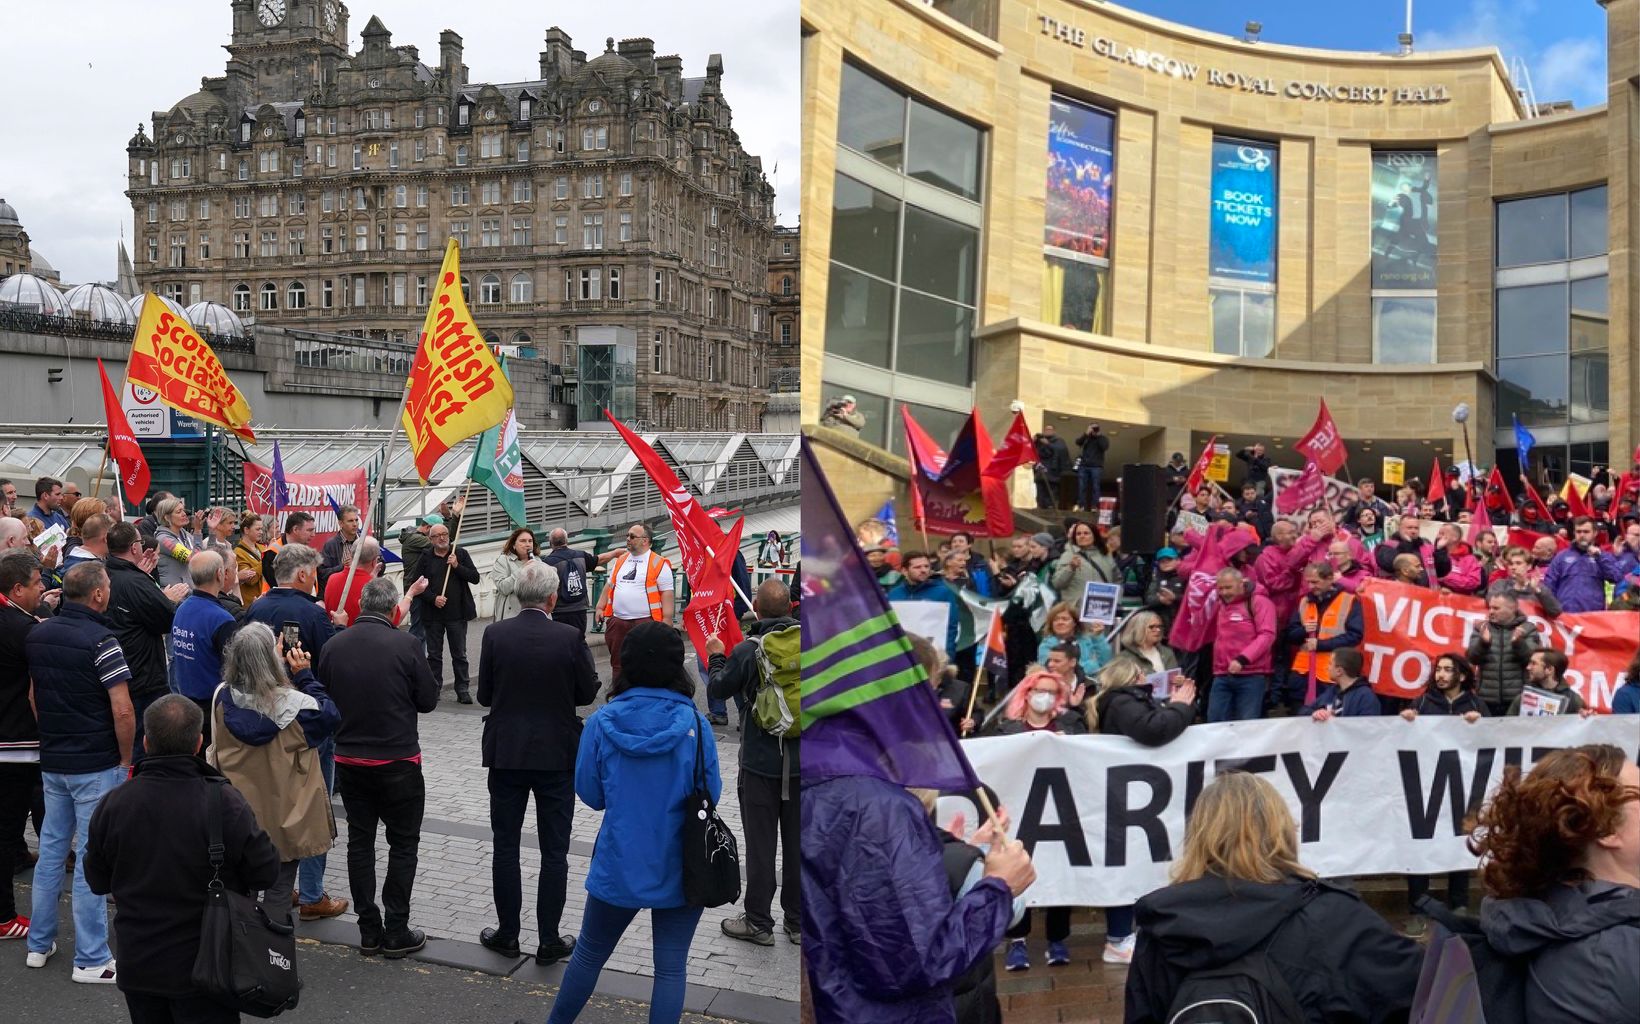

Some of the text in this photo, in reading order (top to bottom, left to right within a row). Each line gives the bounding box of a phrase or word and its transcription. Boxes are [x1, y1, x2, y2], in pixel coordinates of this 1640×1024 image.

[1038, 15, 1451, 104] THE GLASGOW ROYAL CONCERT HALL
[1224, 189, 1264, 204] BOOK
[1214, 199, 1272, 217] TICKETS
[1225, 213, 1261, 227] NOW
[177, 420, 198, 429] Waverley
[321, 483, 356, 506] UNIONS
[172, 625, 188, 638] Clean
[1372, 592, 1584, 656] VICTRY
[1363, 643, 1433, 690] TO
